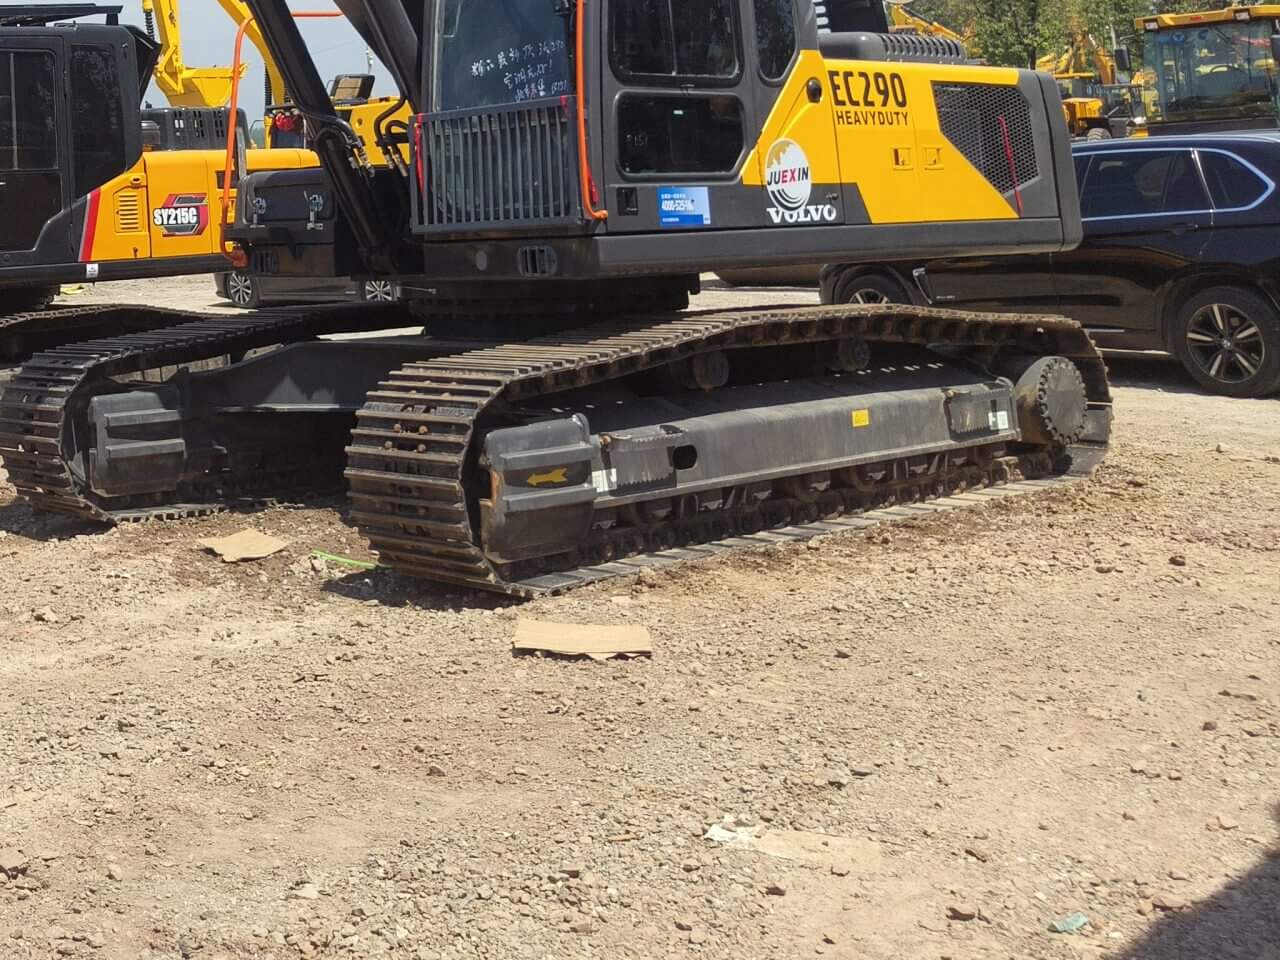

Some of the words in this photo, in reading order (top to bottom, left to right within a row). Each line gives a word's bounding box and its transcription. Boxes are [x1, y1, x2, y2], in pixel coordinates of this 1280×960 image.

[827, 70, 908, 108] EC290
[835, 110, 908, 126] HEAVYDUTY
[767, 166, 809, 186] JUEXIN
[153, 207, 198, 225] SY215C
